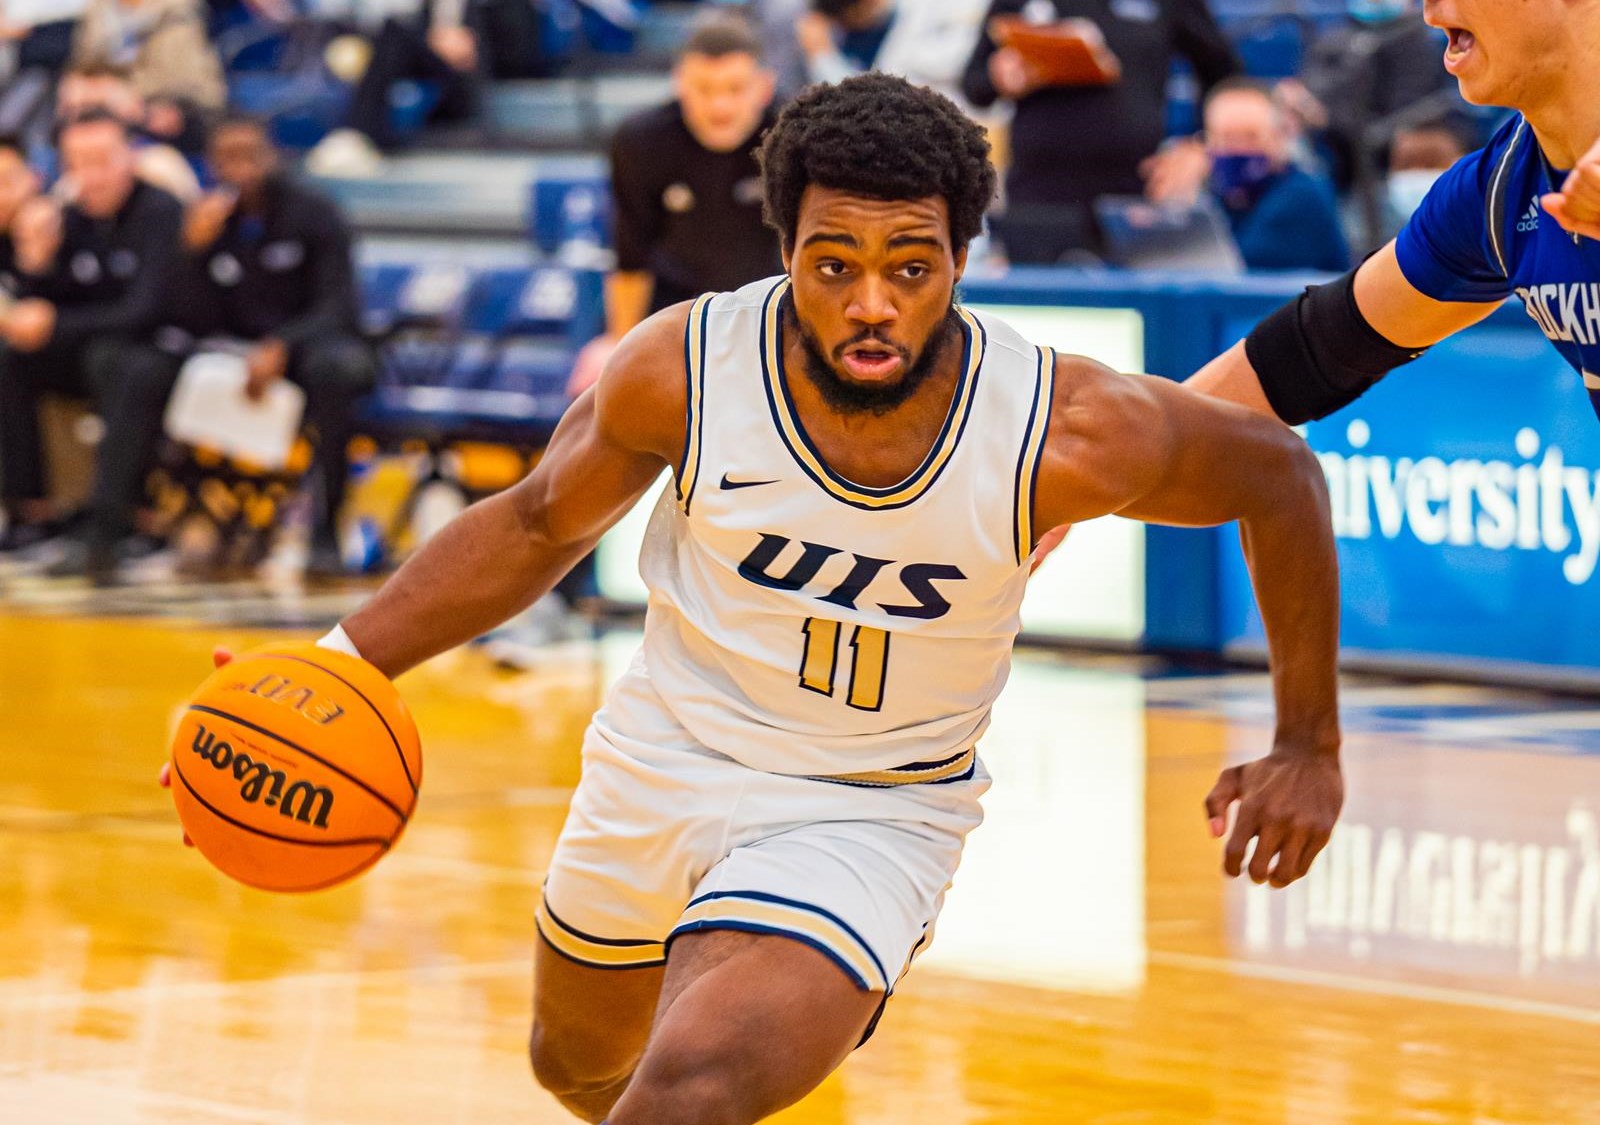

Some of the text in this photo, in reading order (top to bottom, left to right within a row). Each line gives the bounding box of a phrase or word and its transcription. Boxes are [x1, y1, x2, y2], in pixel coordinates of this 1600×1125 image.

[1292, 418, 1600, 586] niversity
[737, 531, 968, 620] UIS
[249, 674, 345, 726] EVO
[798, 616, 891, 713] 11
[191, 722, 335, 830] Wilson
